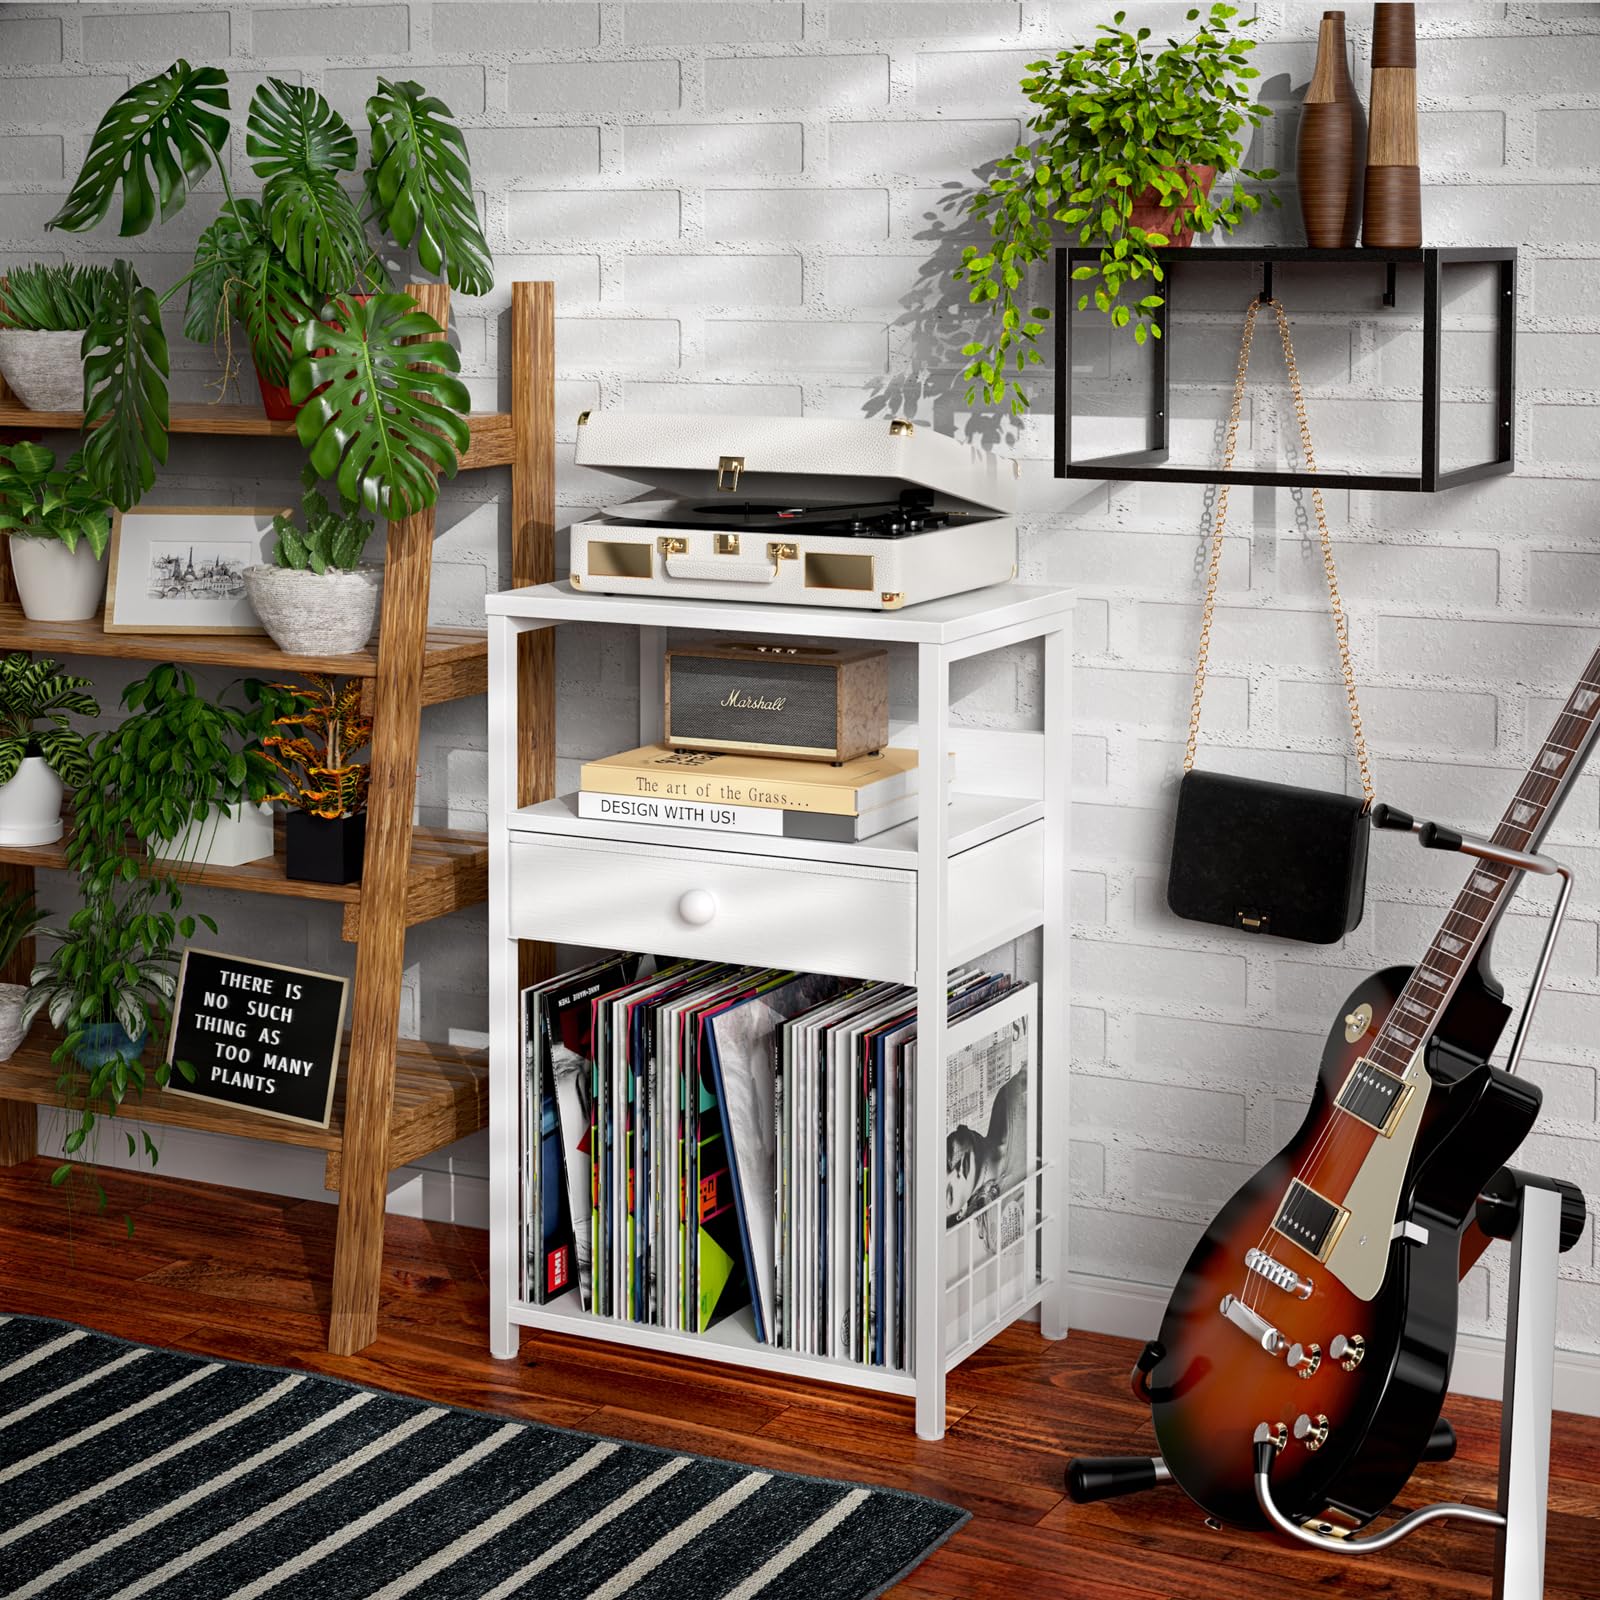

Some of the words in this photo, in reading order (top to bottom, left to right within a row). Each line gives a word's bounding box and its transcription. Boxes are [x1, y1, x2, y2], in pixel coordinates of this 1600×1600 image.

[721, 689, 786, 711] Marshall
[636, 777, 658, 792] The
[667, 783, 687, 795] art
[696, 783, 711, 797] of
[720, 786, 742, 800] the
[748, 788, 809, 807] Grass...
[601, 799, 658, 817] DESIGN
[664, 805, 704, 822] WITH
[711, 810, 736, 825] US!
[220, 970, 274, 995] THERE
[285, 983, 302, 1000] IS
[203, 991, 228, 1009] NO
[246, 1000, 293, 1023] SUCH
[195, 1013, 247, 1038] THING
[258, 1027, 281, 1045] AS
[215, 1042, 251, 1063] TOO
[263, 1053, 314, 1077] MANY
[210, 1066, 276, 1094] PLANTS
